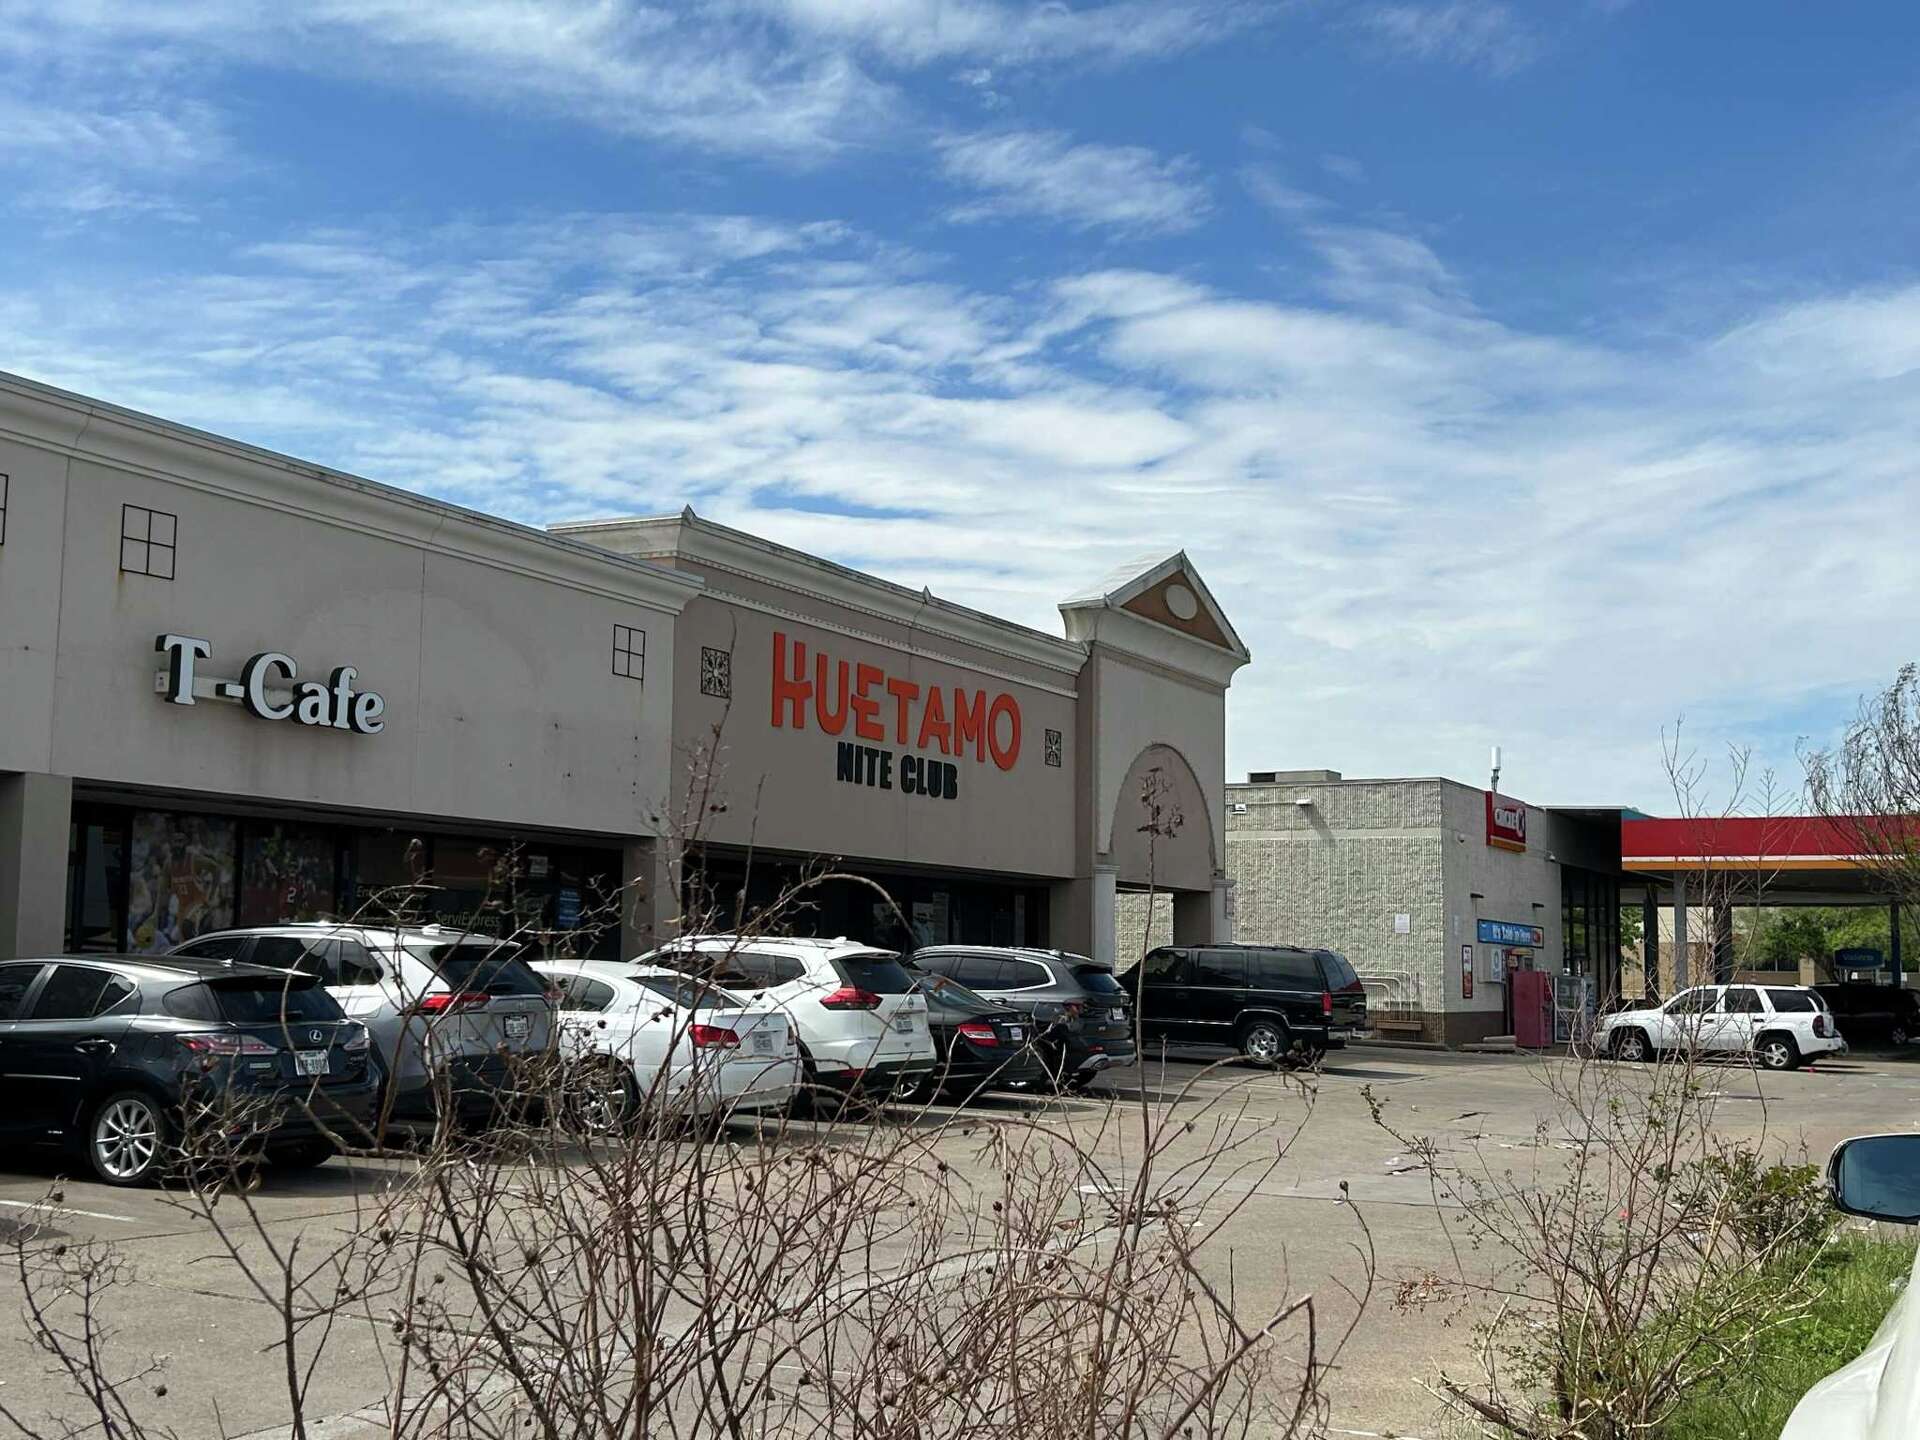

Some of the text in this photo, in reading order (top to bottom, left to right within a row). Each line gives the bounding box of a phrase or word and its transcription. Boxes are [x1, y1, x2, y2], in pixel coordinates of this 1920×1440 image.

[771, 631, 1022, 772] HUETAMO
[837, 741, 958, 800] NITE CLUB
[286, 887, 297, 904] 2
